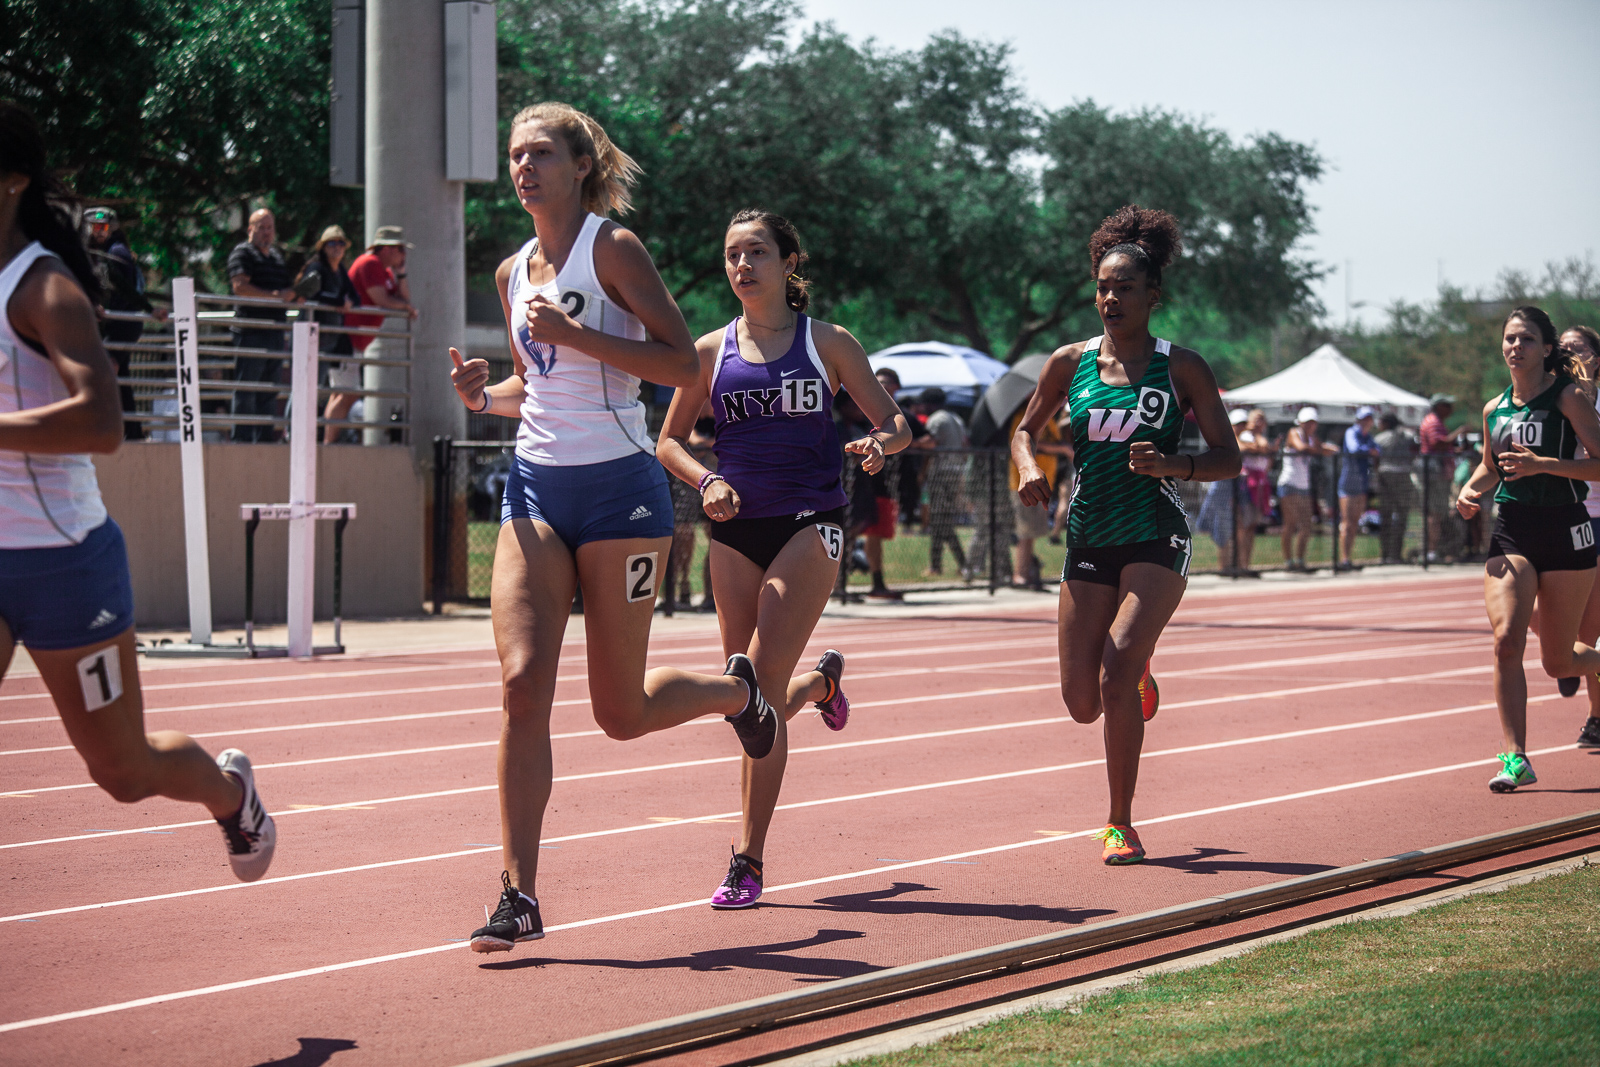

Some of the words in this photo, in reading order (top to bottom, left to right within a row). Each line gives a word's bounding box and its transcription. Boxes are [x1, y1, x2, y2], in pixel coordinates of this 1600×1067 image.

[560, 290, 585, 319] 2
[178, 329, 195, 442] FINISH
[785, 380, 818, 411] 15
[721, 387, 811, 422] NY
[1140, 390, 1165, 425] 9
[1087, 408, 1141, 442] W
[1516, 423, 1537, 445] 10
[629, 510, 653, 521] adidas
[1575, 523, 1592, 547] 10
[630, 556, 653, 600] 2
[86, 655, 112, 702] 1
